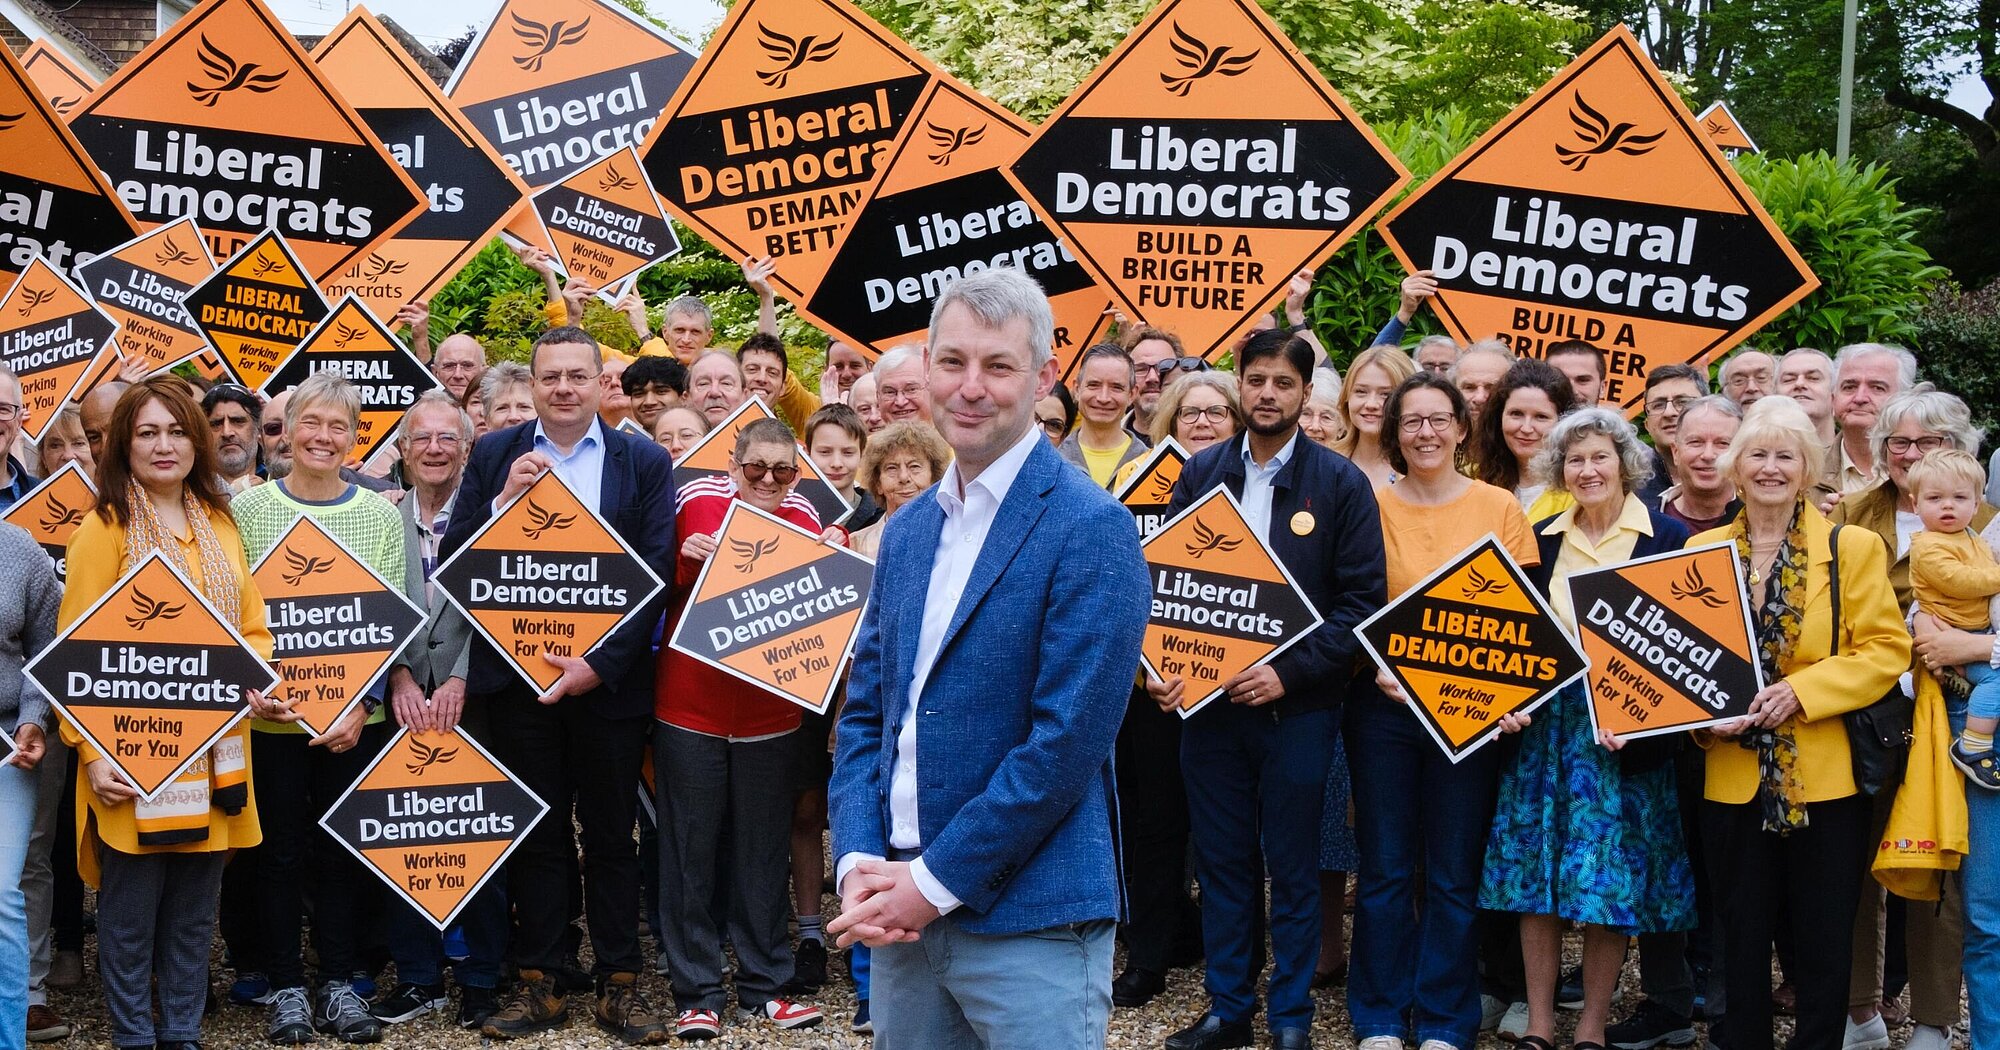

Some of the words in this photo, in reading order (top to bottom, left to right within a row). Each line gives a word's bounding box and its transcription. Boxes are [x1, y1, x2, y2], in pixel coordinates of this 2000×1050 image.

[493, 71, 648, 144] Liberal
[721, 88, 892, 156] Liberal
[500, 108, 666, 179] emocra
[1110, 125, 1297, 173] Liberal
[134, 129, 323, 190] Liberal
[680, 139, 894, 204] Democra
[746, 189, 862, 231] DEMAN
[1055, 172, 1351, 221] Democrats
[574, 195, 643, 234] Liberal
[895, 200, 1043, 258] Libera
[550, 205, 657, 256] Democrats
[765, 222, 846, 258] BETT
[1136, 231, 1223, 256] BUILD
[1231, 234, 1253, 257] A
[1491, 196, 1698, 266] Liberal
[568, 257, 586, 272] For
[588, 263, 608, 280] You
[571, 241, 615, 268] Working
[128, 269, 185, 304] Liber
[1122, 257, 1265, 285] BRIGHTER
[1431, 235, 1750, 321] Democrats
[100, 278, 197, 329] Democr
[225, 284, 304, 315] LIBERAL
[326, 283, 403, 299] mocrats
[1138, 285, 1245, 311] FUTURE
[3, 318, 73, 356] Liberal
[126, 318, 174, 347] Working
[1512, 307, 1606, 341] BUILD
[1613, 323, 1636, 348] A
[3, 337, 94, 373] mocrats
[122, 335, 141, 351] For
[145, 342, 166, 361] You
[238, 343, 280, 361] Working
[238, 357, 255, 370] For
[257, 360, 276, 374] You
[21, 377, 57, 395] orking
[34, 396, 55, 410] You
[356, 435, 371, 446] ou
[500, 555, 598, 582] Liberal
[470, 578, 628, 607] Democrats
[727, 566, 823, 621] Liberal
[1156, 570, 1259, 609] Liberal
[265, 597, 363, 628] Liberal
[512, 617, 575, 639] Working
[708, 584, 859, 652] Democrats
[1150, 598, 1284, 638] emocrats
[1421, 608, 1532, 647] LIBERAL
[272, 622, 395, 651] mocrats
[514, 640, 539, 657] For
[543, 640, 572, 657] You
[1161, 633, 1226, 662] Working
[1624, 595, 1723, 673] Liberal
[101, 646, 209, 677] Liberal
[762, 634, 825, 666] Working
[1387, 633, 1558, 681] DEMOCRATS
[1586, 598, 1731, 710] Democrats
[282, 663, 346, 682] Working
[773, 667, 797, 685] For
[799, 655, 830, 675] You
[1160, 655, 1186, 675] For
[1190, 660, 1219, 681] You
[1605, 655, 1665, 708] Working
[67, 671, 241, 703] Democrats
[287, 686, 311, 703] For
[315, 684, 345, 701] You
[1438, 682, 1496, 706] Working
[1595, 676, 1621, 702] For
[1621, 693, 1649, 723] You
[113, 714, 183, 737] Working
[1437, 700, 1461, 717] For
[1463, 704, 1491, 722] You
[116, 738, 143, 757] For
[147, 739, 179, 758] You
[387, 786, 484, 817] Liberal
[359, 812, 515, 842] Democrats
[404, 852, 466, 870] Working
[408, 875, 432, 891] For
[436, 872, 465, 889] You
